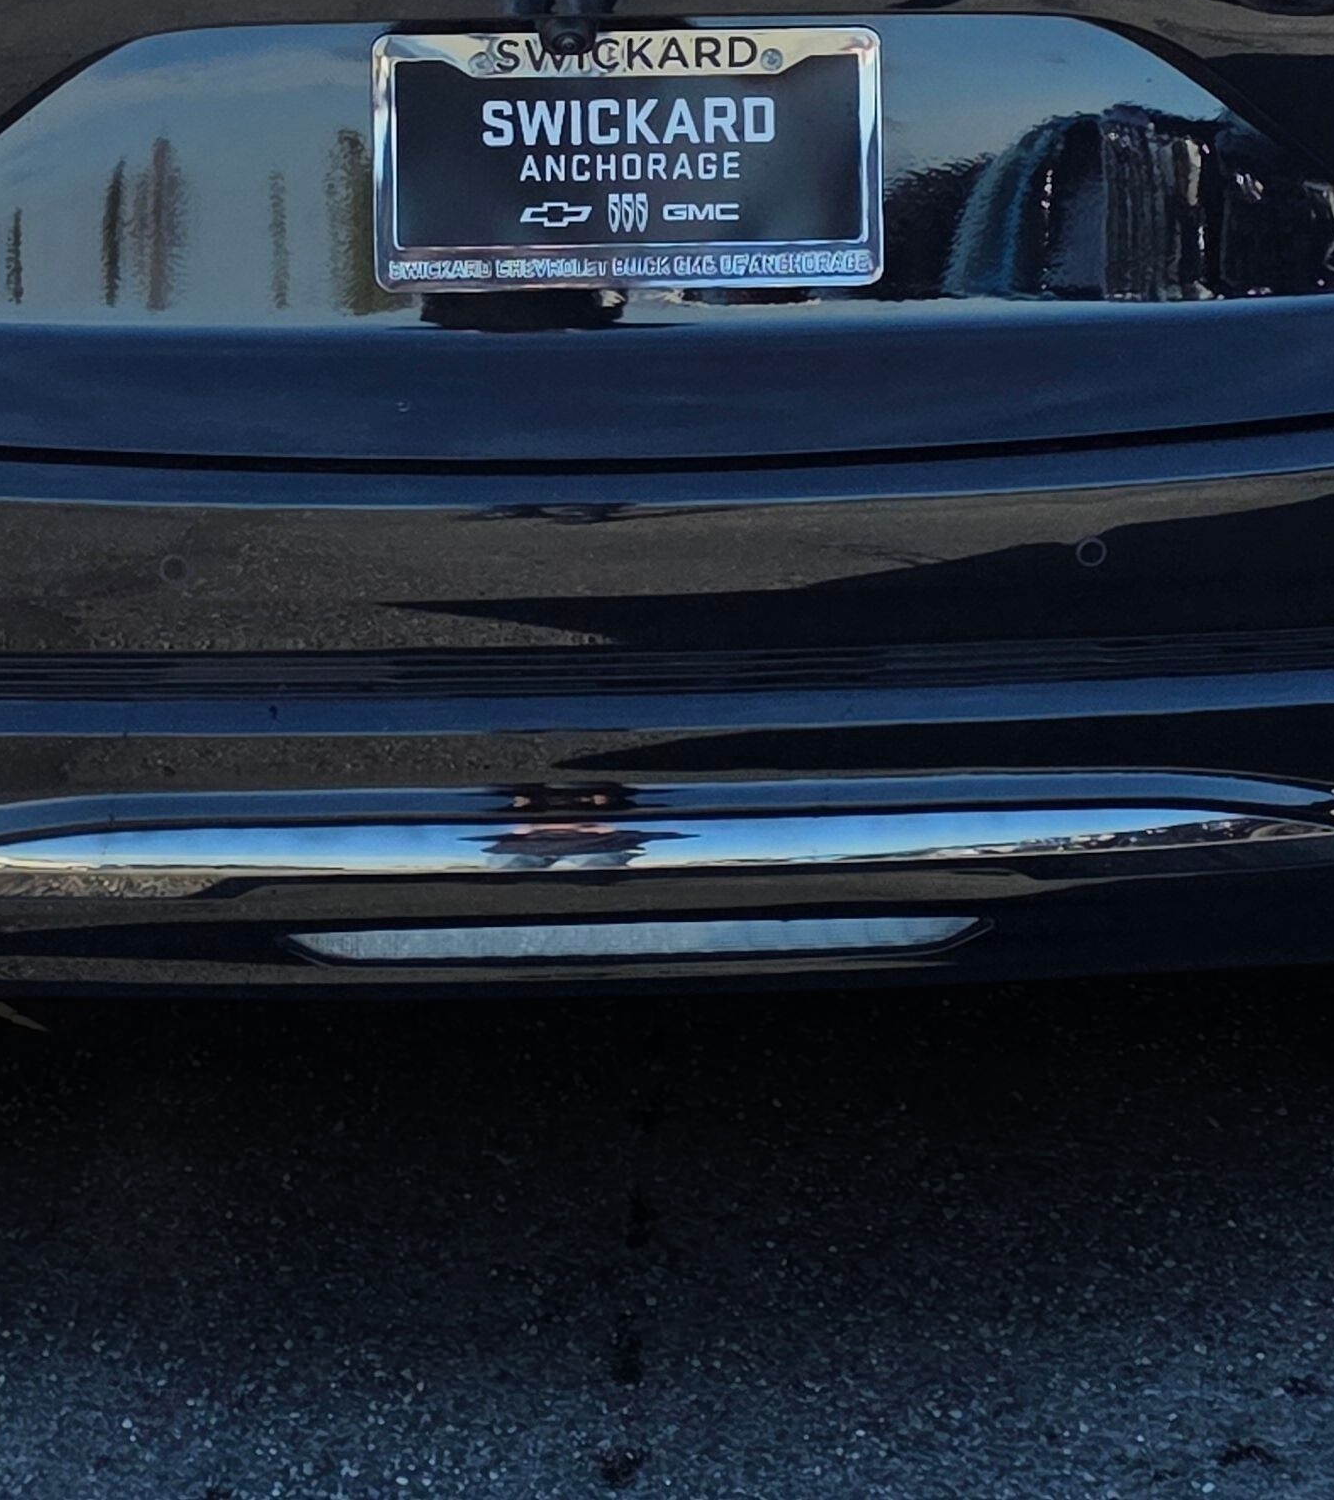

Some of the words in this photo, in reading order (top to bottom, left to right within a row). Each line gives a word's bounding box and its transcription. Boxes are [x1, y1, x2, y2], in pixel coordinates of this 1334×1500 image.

[496, 36, 758, 73] SWICKARD
[482, 97, 775, 147] SWICKARD
[519, 151, 741, 182] ANCHORAGE
[662, 203, 740, 221] GMC
[388, 259, 492, 280] SWICKARD
[496, 258, 608, 279] CHEVROLET
[612, 256, 670, 277] BUICK
[749, 250, 874, 275] ANCHORAGE
